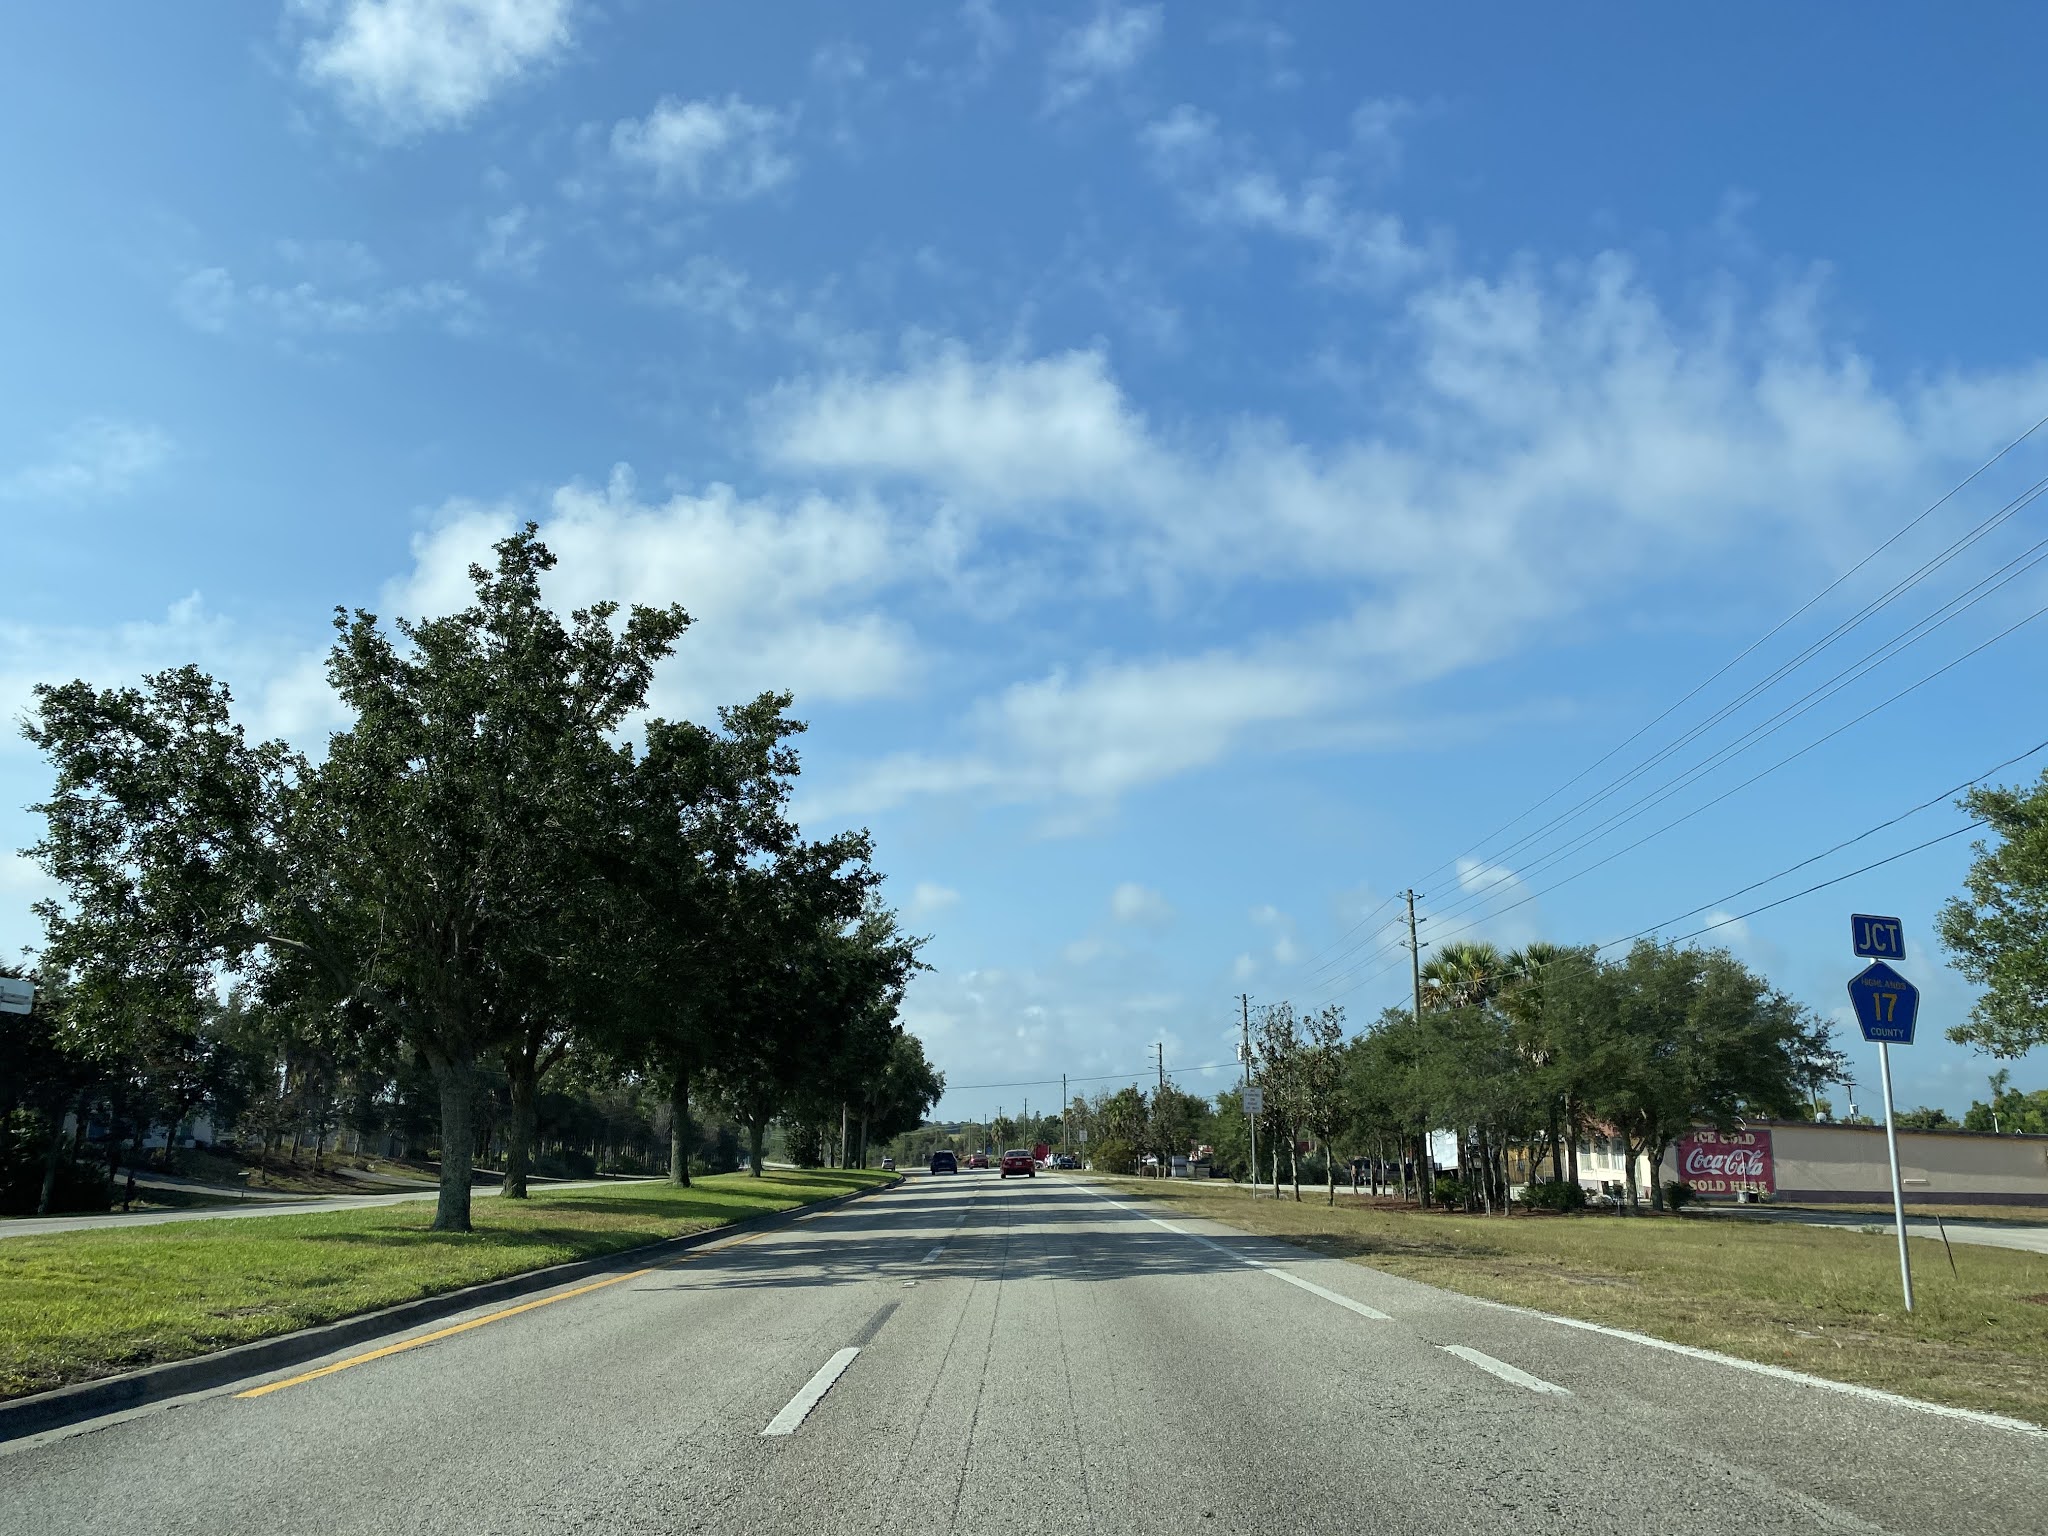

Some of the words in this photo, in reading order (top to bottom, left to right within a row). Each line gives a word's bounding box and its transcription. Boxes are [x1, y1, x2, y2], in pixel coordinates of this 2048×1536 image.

[1860, 922, 1898, 953] JCT
[1873, 992, 1898, 1022] 17
[1870, 1026, 1905, 1038] COUNTY
[1693, 1131, 1717, 1144] ICE
[1685, 1147, 1765, 1176] Coca-Cola
[1688, 1179, 1726, 1192] SOLD
